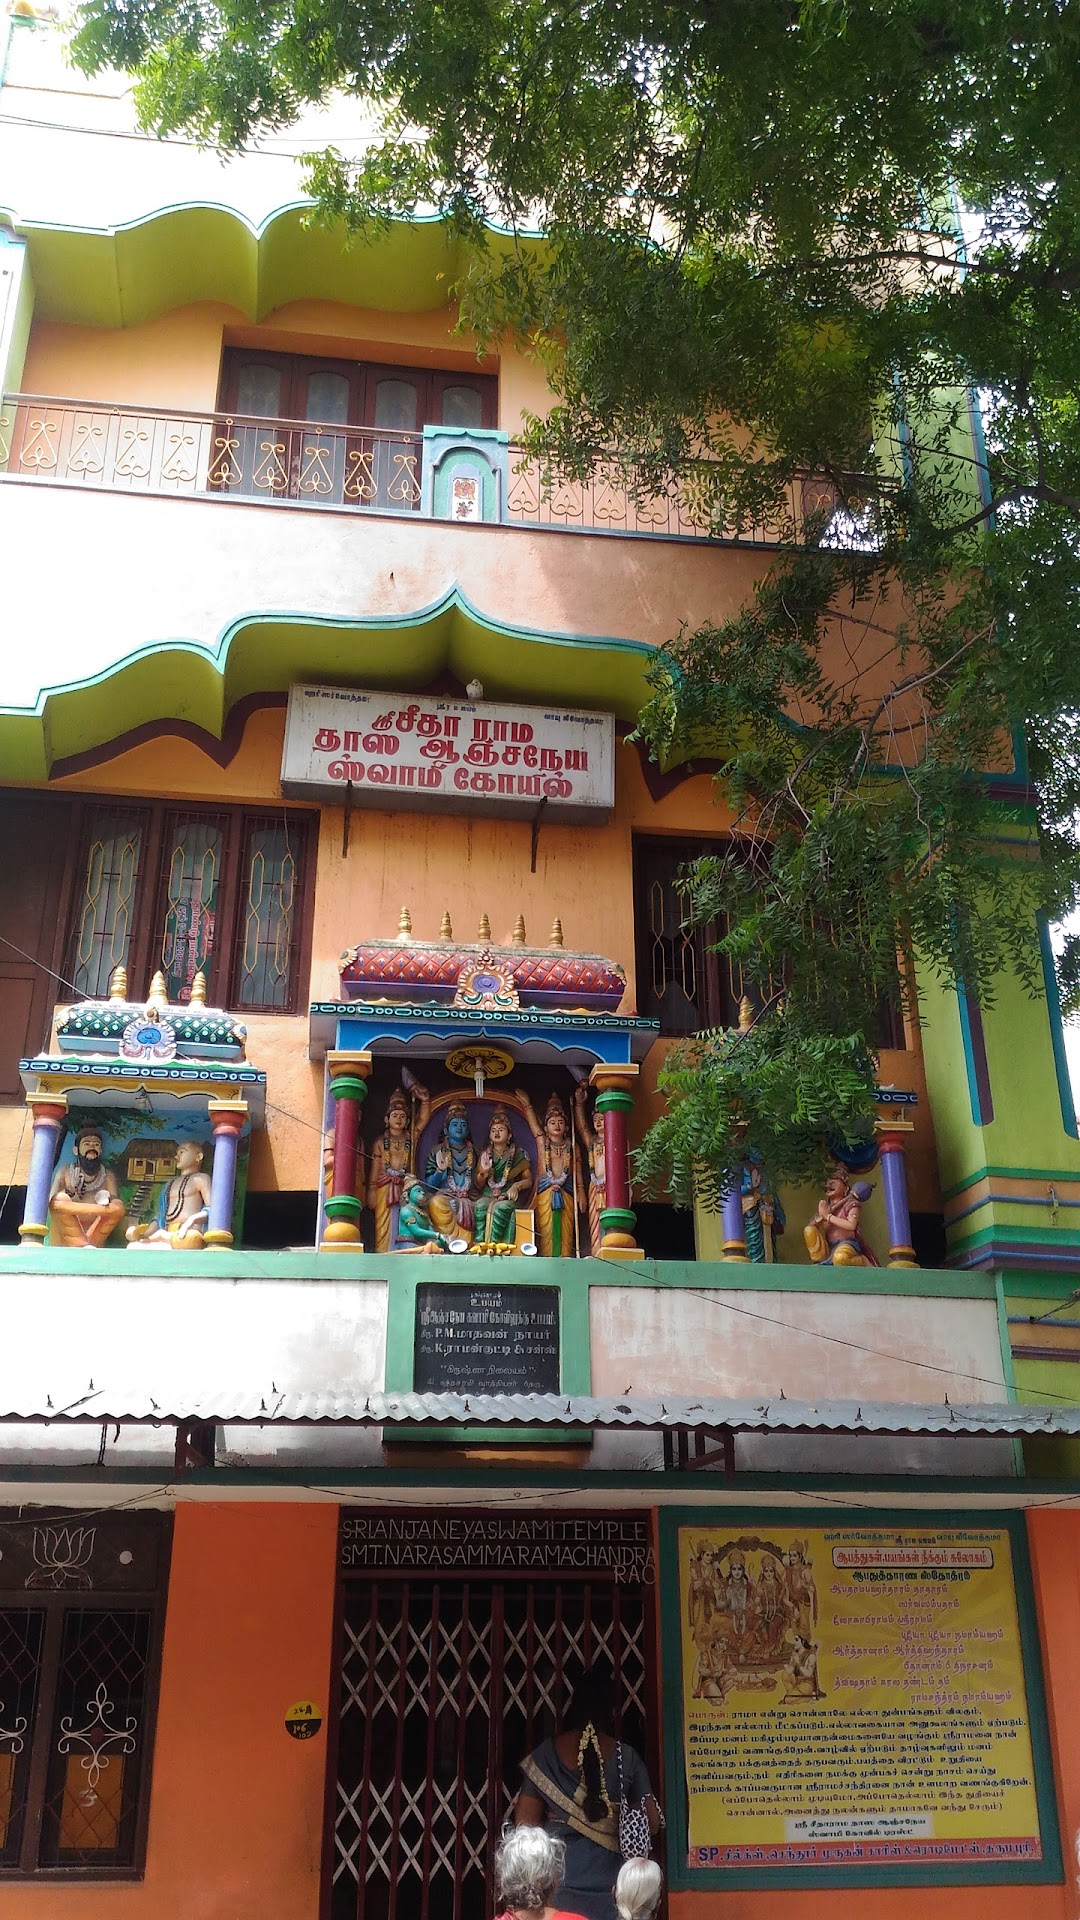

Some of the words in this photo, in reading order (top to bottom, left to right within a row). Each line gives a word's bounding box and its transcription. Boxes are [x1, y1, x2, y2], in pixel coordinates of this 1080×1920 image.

[471, 718, 534, 743] ராம
[313, 728, 400, 755] தாஸ
[419, 737, 589, 772] ஆஞ்சநேய
[327, 753, 447, 788] ஸ்வாமி
[453, 765, 573, 798] கோயில்
[513, 1329, 551, 1341] நாயர்
[921, 1550, 948, 1565] நீக்கும்
[612, 1565, 656, 1585] RAO
[731, 1711, 757, 1720] ராமா
[760, 1709, 788, 1720] என்று
[789, 1708, 847, 1719] சொன்னாலே
[849, 1707, 879, 1716] எல்லா
[881, 1707, 943, 1717] துன்பங்களும்
[734, 1721, 772, 1731] எல்லாம்
[688, 1735, 719, 1745] இப்படி
[722, 1734, 748, 1743] மனம்
[897, 1731, 940, 1741] வழங்கும்
[995, 1730, 1017, 1740] நான்
[689, 1747, 739, 1757] எப்போதும்
[859, 1744, 896, 1754] ஏற்படும்
[968, 1742, 993, 1751] மனம்
[689, 1757, 737, 1768] கலங்காத
[898, 1755, 935, 1765] விரட்டும்
[776, 1769, 823, 1780] எதிரிகளை
[826, 1769, 857, 1779] நமக்கு
[901, 1767, 934, 1777] சென்று
[936, 1766, 964, 1776] நாசம்
[966, 1766, 997, 1776] செய்து
[690, 1784, 732, 1794] நம்மைக்
[735, 1782, 802, 1793] காப்பவருமான
[892, 1779, 915, 1789] நான்
[939, 1791, 963, 1800] இந்த
[832, 1803, 887, 1814] நலன்களும்
[941, 1802, 967, 1812] வந்து
